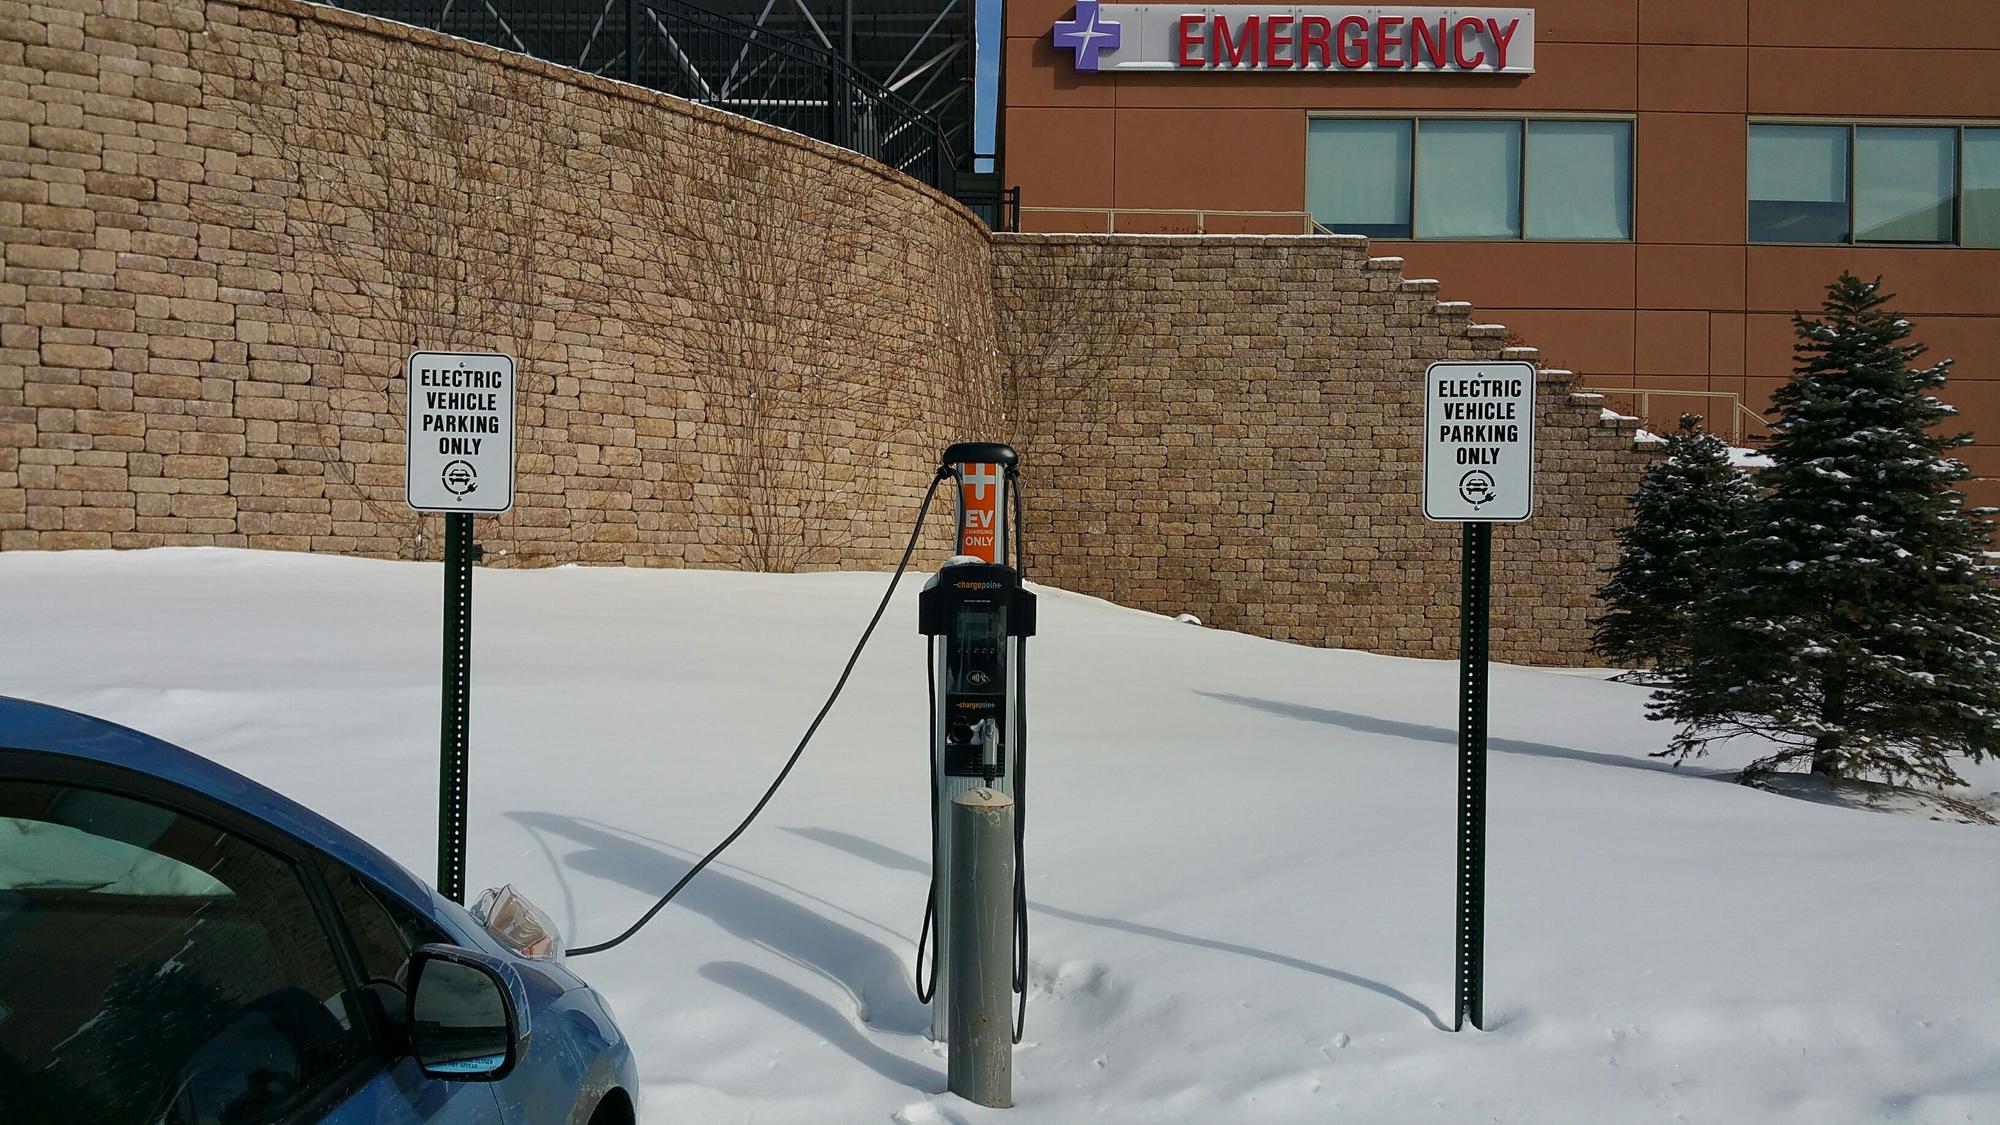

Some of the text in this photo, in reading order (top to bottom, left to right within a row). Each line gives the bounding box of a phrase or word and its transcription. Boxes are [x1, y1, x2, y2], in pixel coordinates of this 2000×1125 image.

[1179, 14, 1520, 70] EMERGENCY
[421, 369, 502, 389] ELECTRIC
[1438, 379, 1522, 398] ELECTRIC
[426, 391, 497, 411] VEHICLE
[1444, 402, 1516, 420] VEHICLE
[423, 414, 499, 434] PARKING
[1440, 425, 1518, 443] PARKING
[439, 437, 482, 456] ONLY
[1456, 447, 1500, 465] ONLY
[965, 509, 994, 528] EV
[965, 536, 994, 547] ONLY
